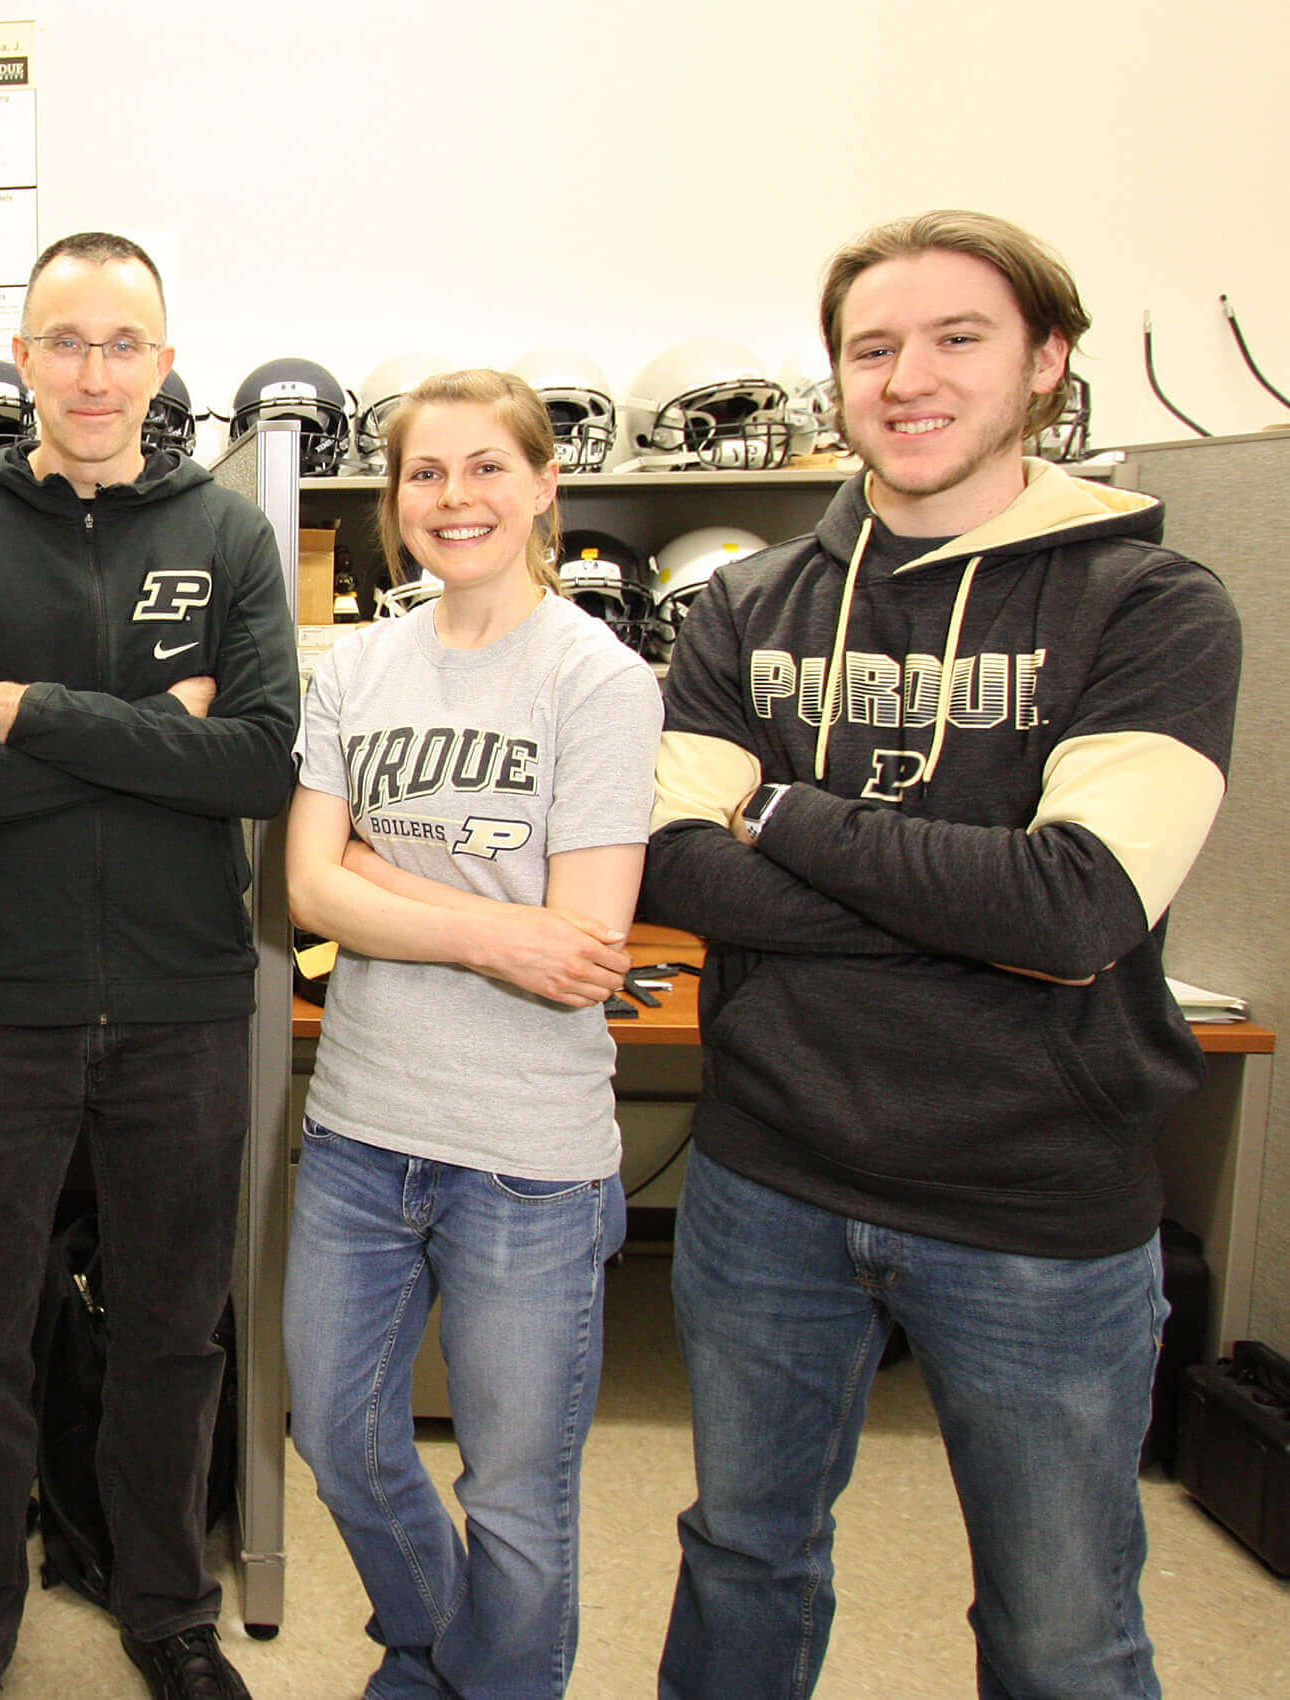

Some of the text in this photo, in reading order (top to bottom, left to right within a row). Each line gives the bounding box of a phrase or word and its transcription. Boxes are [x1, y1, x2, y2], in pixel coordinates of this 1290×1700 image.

[132, 570, 212, 621] P
[751, 648, 1047, 730] PURDUE
[346, 727, 538, 824] URDUE
[861, 749, 927, 802] P
[370, 816, 446, 842] BOILERS
[452, 816, 532, 861] P
